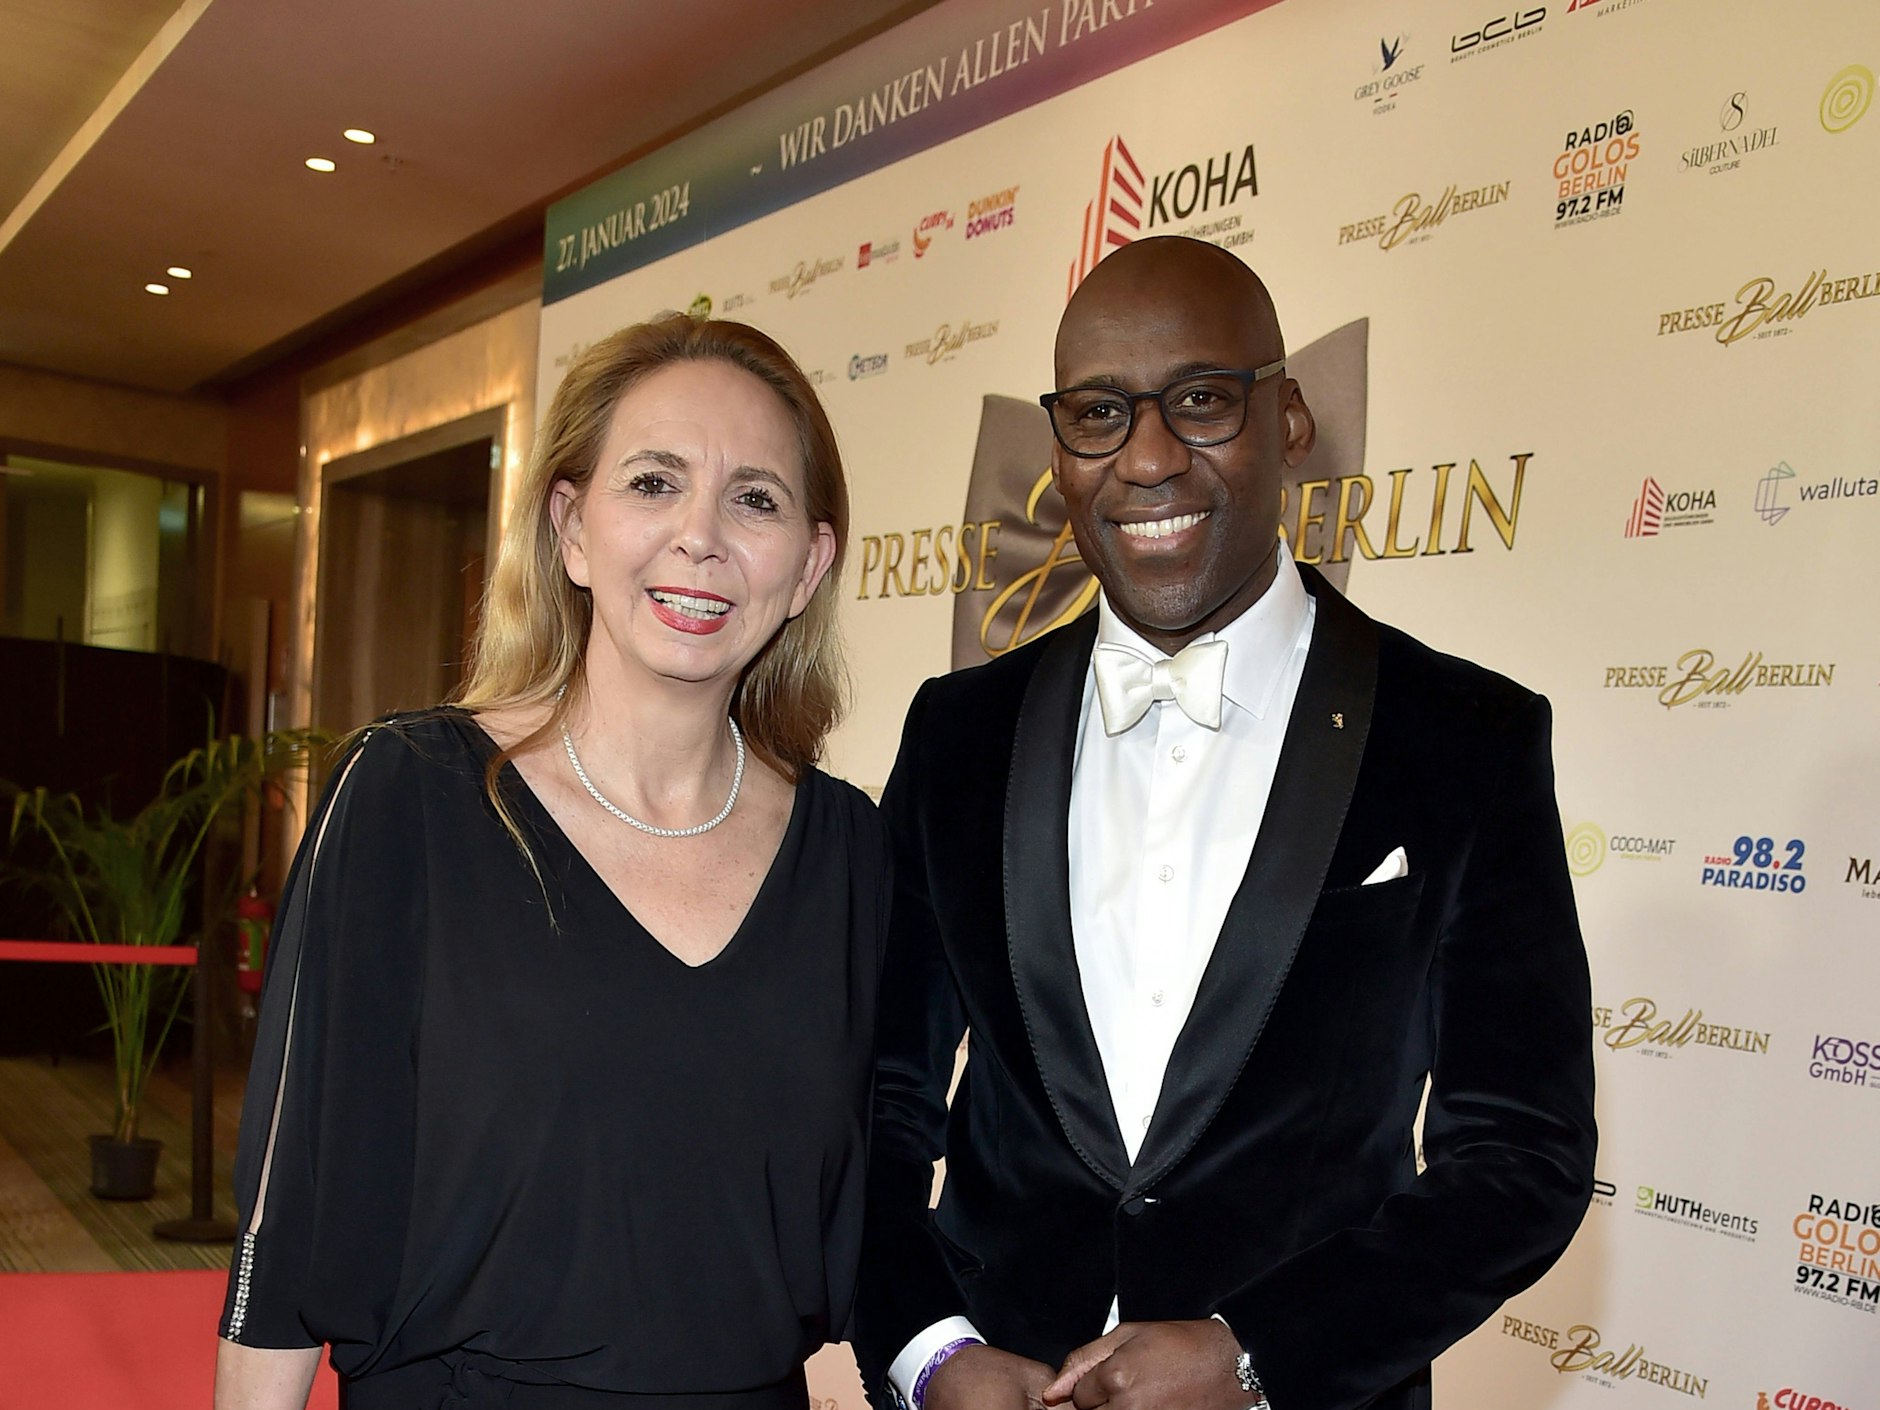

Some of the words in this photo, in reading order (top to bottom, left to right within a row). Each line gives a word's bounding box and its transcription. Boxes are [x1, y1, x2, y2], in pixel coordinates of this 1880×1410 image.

[1354, 82, 1381, 101] GREY
[1383, 65, 1423, 91] GOOSE
[580, 202, 646, 270] JANUAR
[649, 181, 691, 232] 2024
[779, 115, 826, 171] WIR
[832, 56, 948, 149] DANKEN
[950, 8, 1050, 96] ALLEN
[1553, 132, 1640, 179] GOLOS
[1149, 144, 1258, 228] KOHA
[1558, 163, 1628, 199] BERLIN
[966, 206, 1014, 240] DONUTS
[1338, 215, 1386, 246] PRESSE
[1378, 184, 1457, 252] Ball
[1450, 180, 1511, 216] BERLIN
[1556, 195, 1591, 220] 97.2
[1596, 186, 1624, 210] FM
[1656, 302, 1726, 337] PRESSE
[1715, 268, 1828, 348] Ball
[1277, 452, 1534, 566] ERLIN
[1665, 490, 1716, 512] KOHA
[1800, 477, 1878, 502] walluta
[857, 520, 1001, 601] PRESSE
[1603, 666, 1668, 688] PRESSE
[1658, 648, 1763, 711] Ball
[1755, 664, 1836, 688] BERLIN
[1610, 836, 1676, 855] COCO-MAT
[1704, 855, 1732, 866] RADIO
[1733, 835, 1806, 871] 98.2
[1701, 867, 1806, 894] PARADISO
[1603, 997, 1703, 1053] Ball
[1695, 1021, 1772, 1055] BERLIN
[1809, 1062, 1867, 1087] GmbH
[1654, 1192, 1759, 1234] HUTHevents
[1796, 1265, 1840, 1293] 97.2
[1846, 1278, 1880, 1304] FM
[1501, 1315, 1560, 1351] PRESSE
[1550, 1324, 1645, 1381] Ball
[1637, 1358, 1710, 1400] BERLIN
